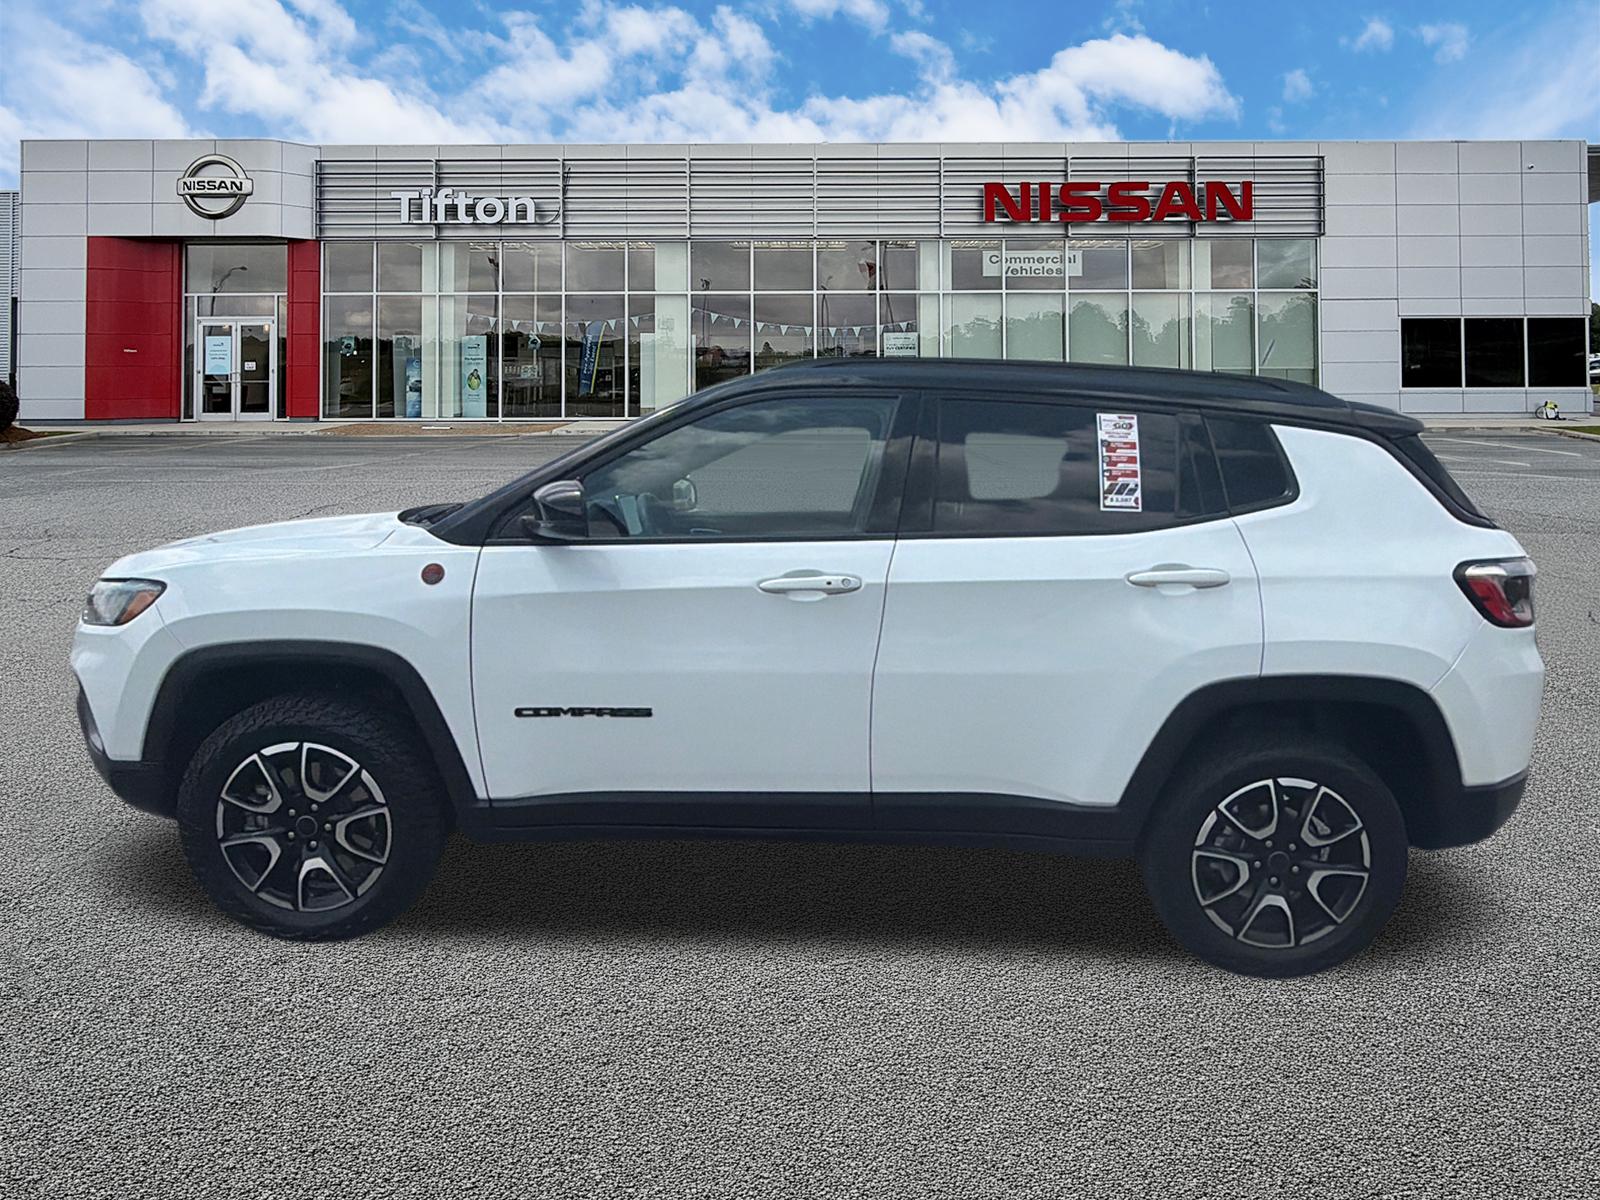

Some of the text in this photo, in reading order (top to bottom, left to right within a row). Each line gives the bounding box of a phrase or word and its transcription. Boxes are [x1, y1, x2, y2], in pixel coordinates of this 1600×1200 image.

[182, 180, 243, 192] NISSAN
[391, 188, 535, 224] Tifton
[983, 181, 1253, 222] NISSAN
[514, 707, 652, 717] COMPASS
